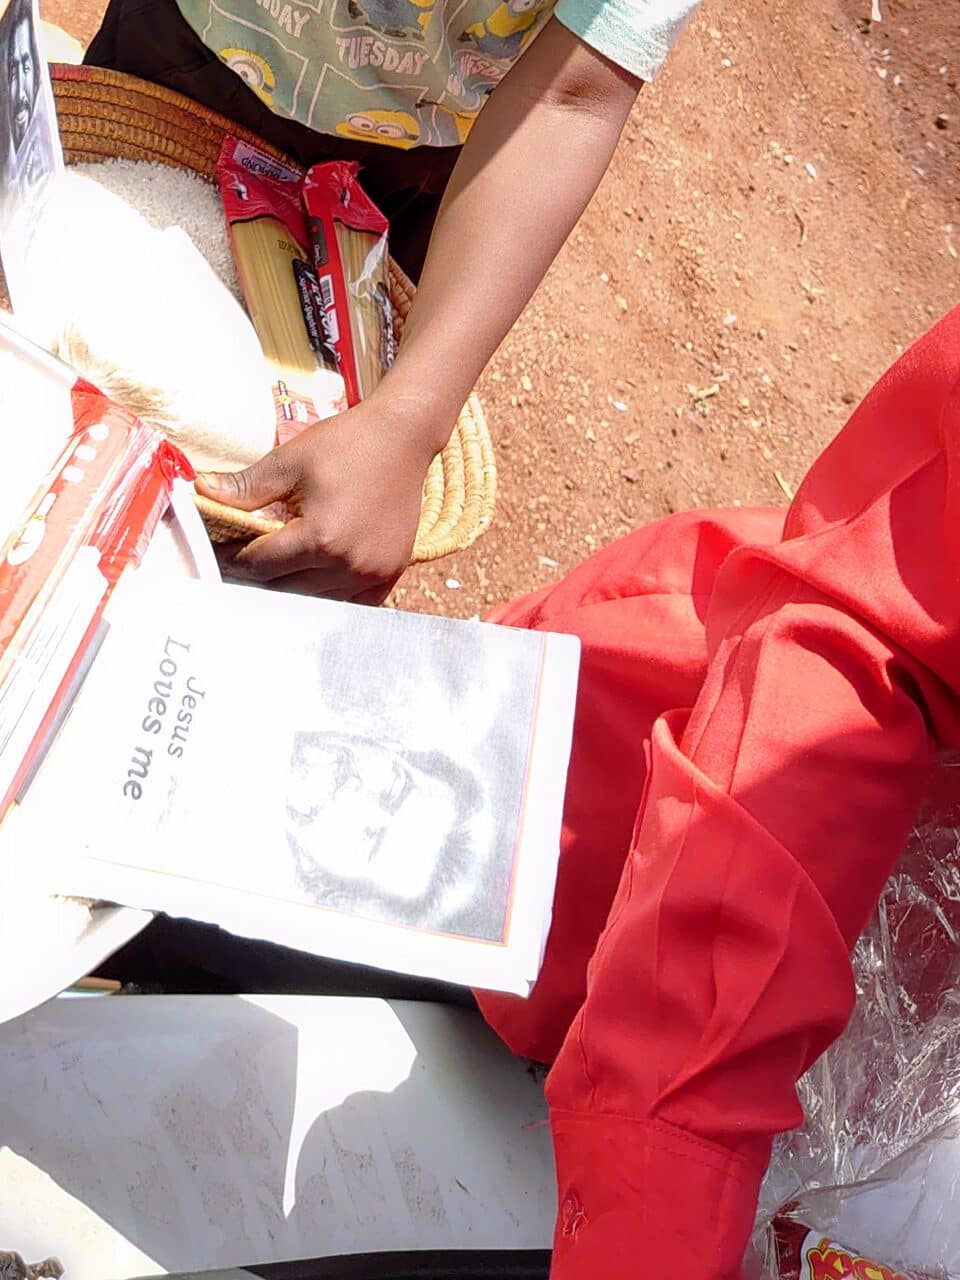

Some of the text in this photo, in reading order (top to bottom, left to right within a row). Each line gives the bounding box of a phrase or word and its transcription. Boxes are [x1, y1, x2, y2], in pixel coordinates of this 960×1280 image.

[336, 36, 430, 75] TUESDAY
[142, 636, 191, 734] Loves
[168, 676, 206, 758] Jesus
[123, 746, 153, 800] me
